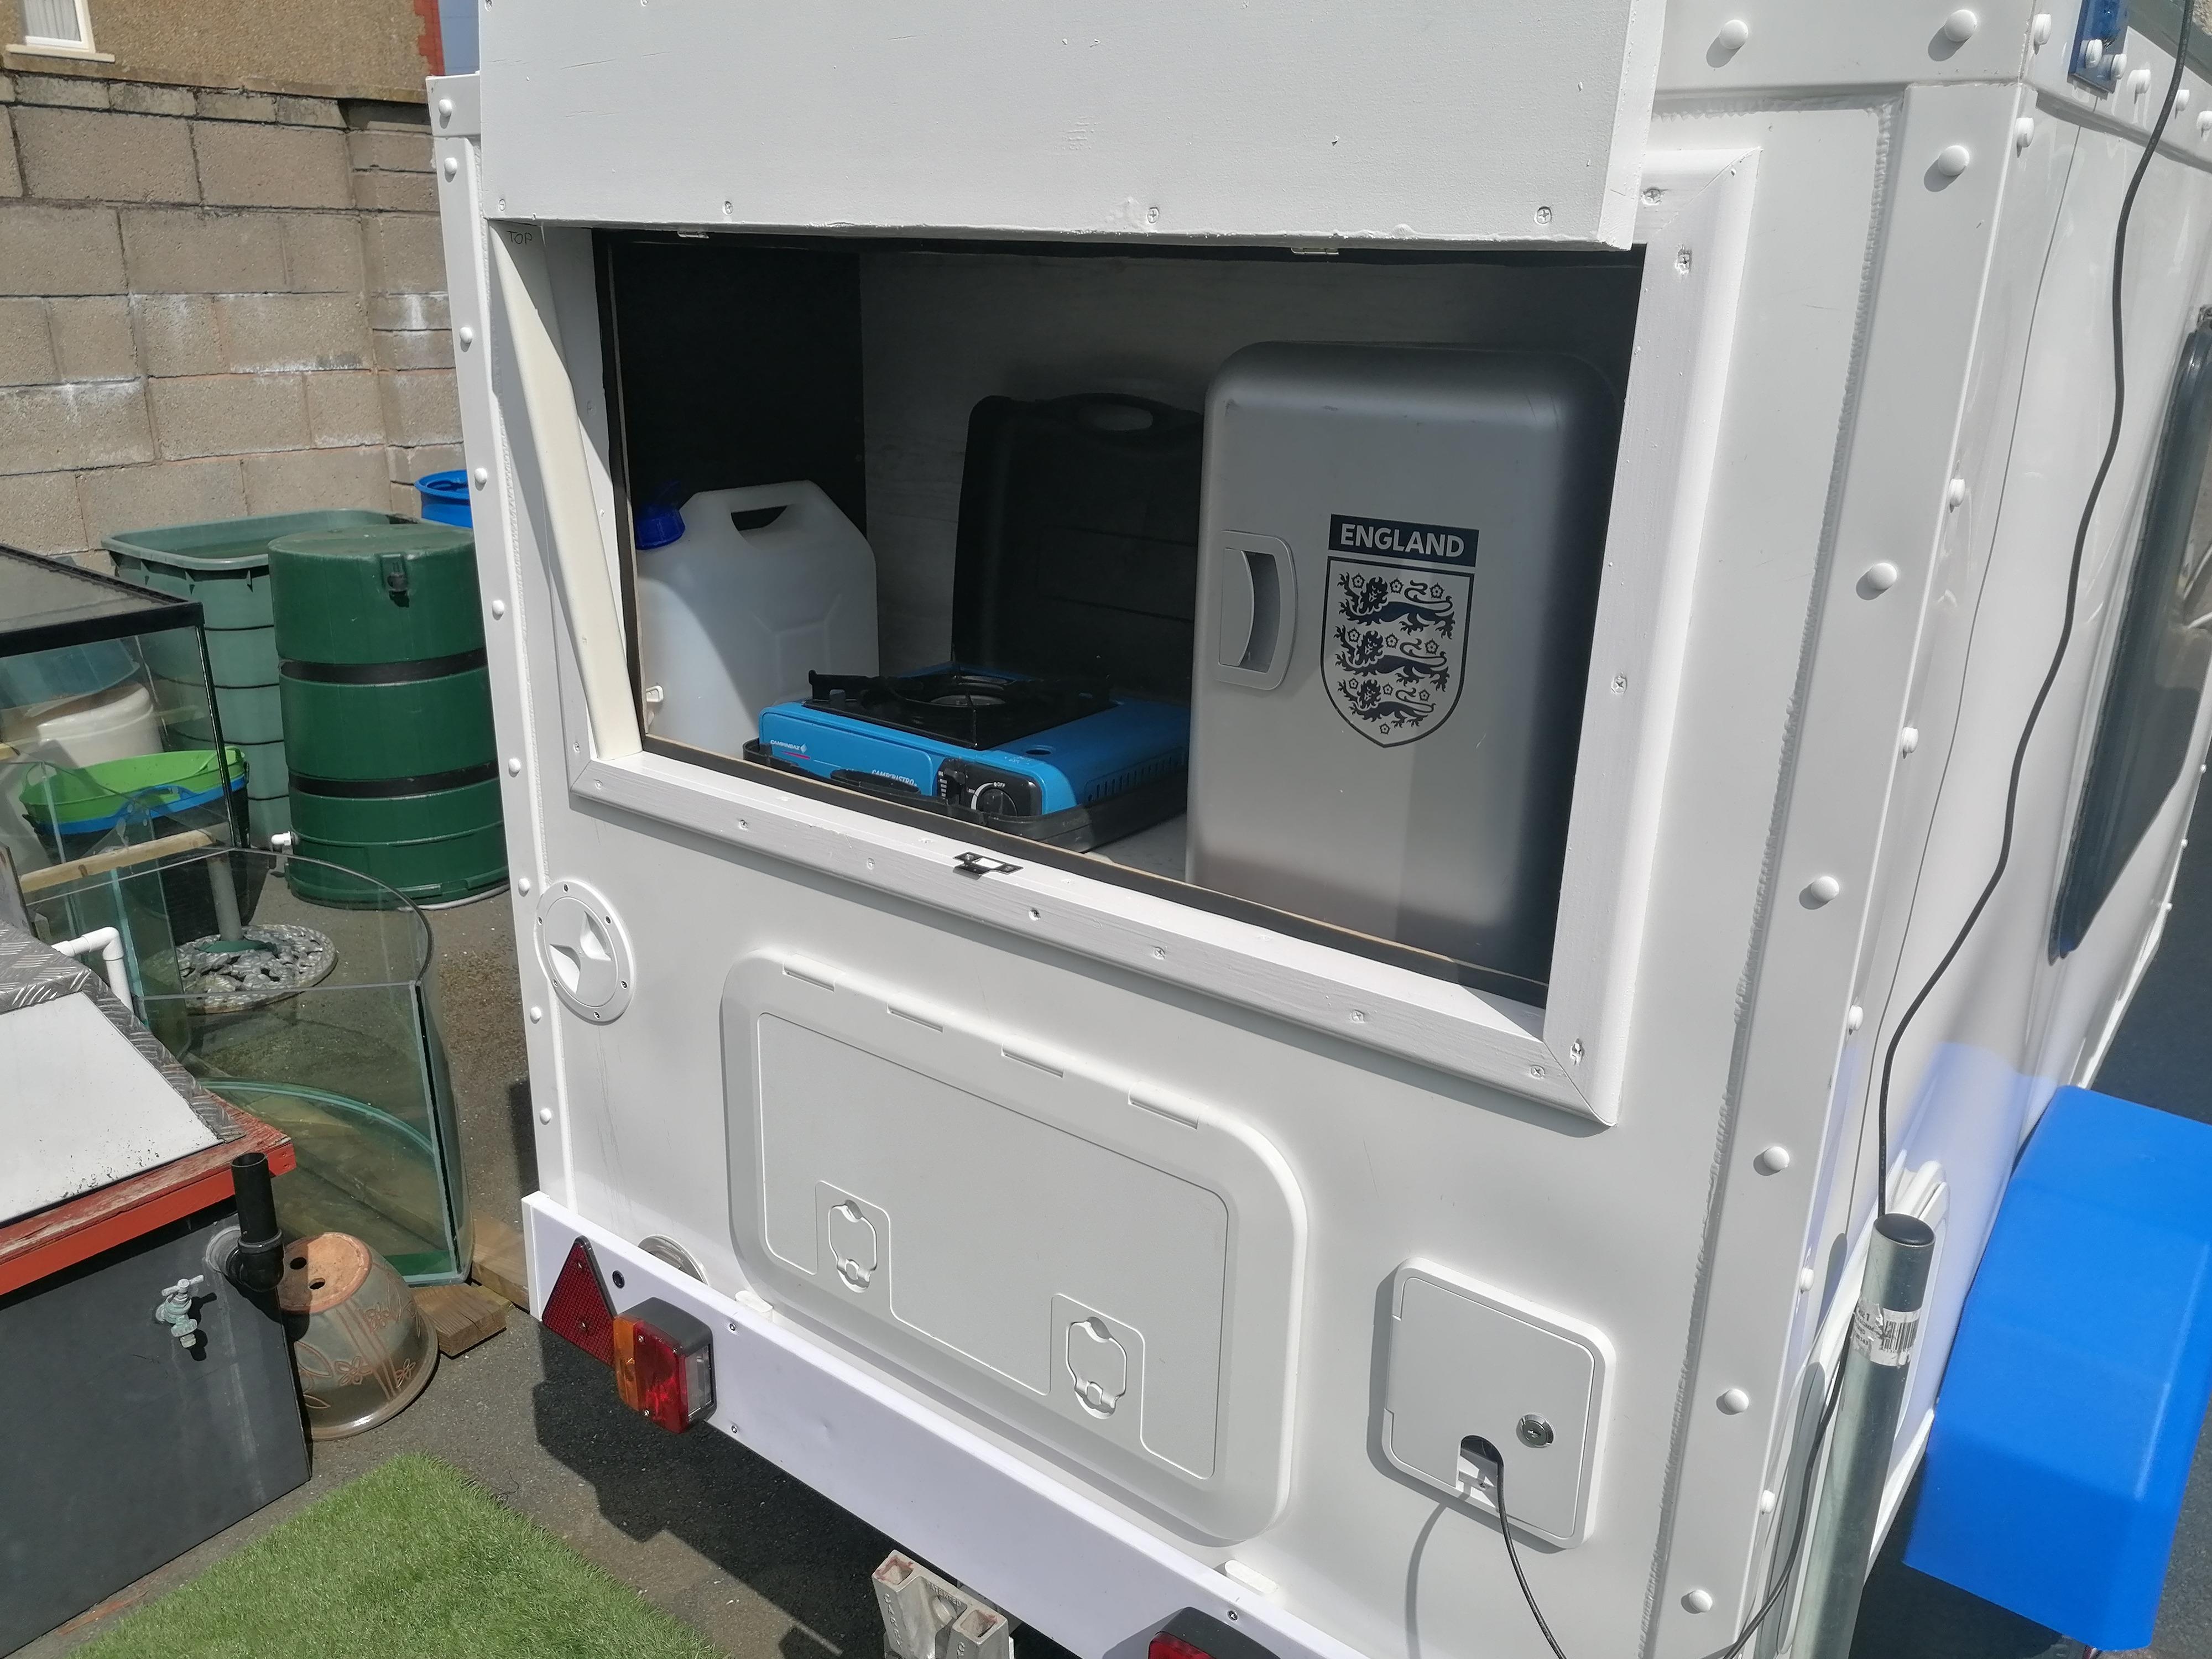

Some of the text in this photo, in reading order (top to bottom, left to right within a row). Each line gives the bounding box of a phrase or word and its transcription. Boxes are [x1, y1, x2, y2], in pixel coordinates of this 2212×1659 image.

[507, 230, 533, 245] TOP
[1340, 523, 1464, 557] ENGLAND
[925, 1580, 962, 1606] PATENTED
